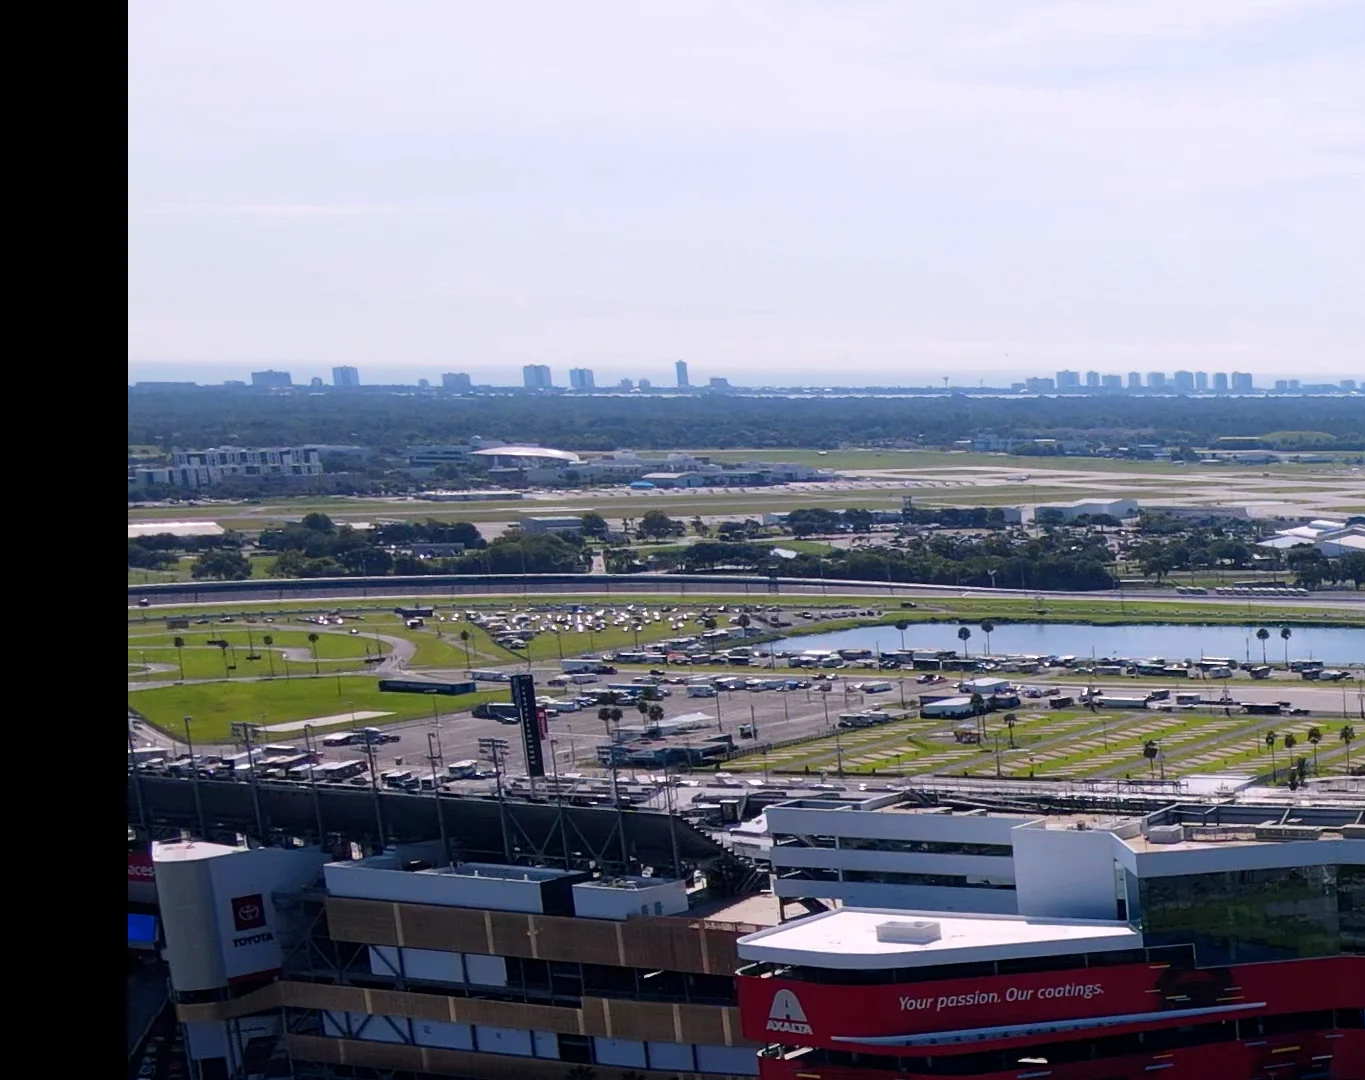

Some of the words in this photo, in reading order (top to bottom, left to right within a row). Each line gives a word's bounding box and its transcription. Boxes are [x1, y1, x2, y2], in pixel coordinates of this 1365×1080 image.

[232, 933, 274, 948] TOYOTA
[899, 996, 933, 1011] Your
[937, 990, 1001, 1012] passion.
[1005, 987, 1034, 1002] Our
[1037, 983, 1104, 999] coatings.
[765, 1019, 814, 1035] AXALTA
